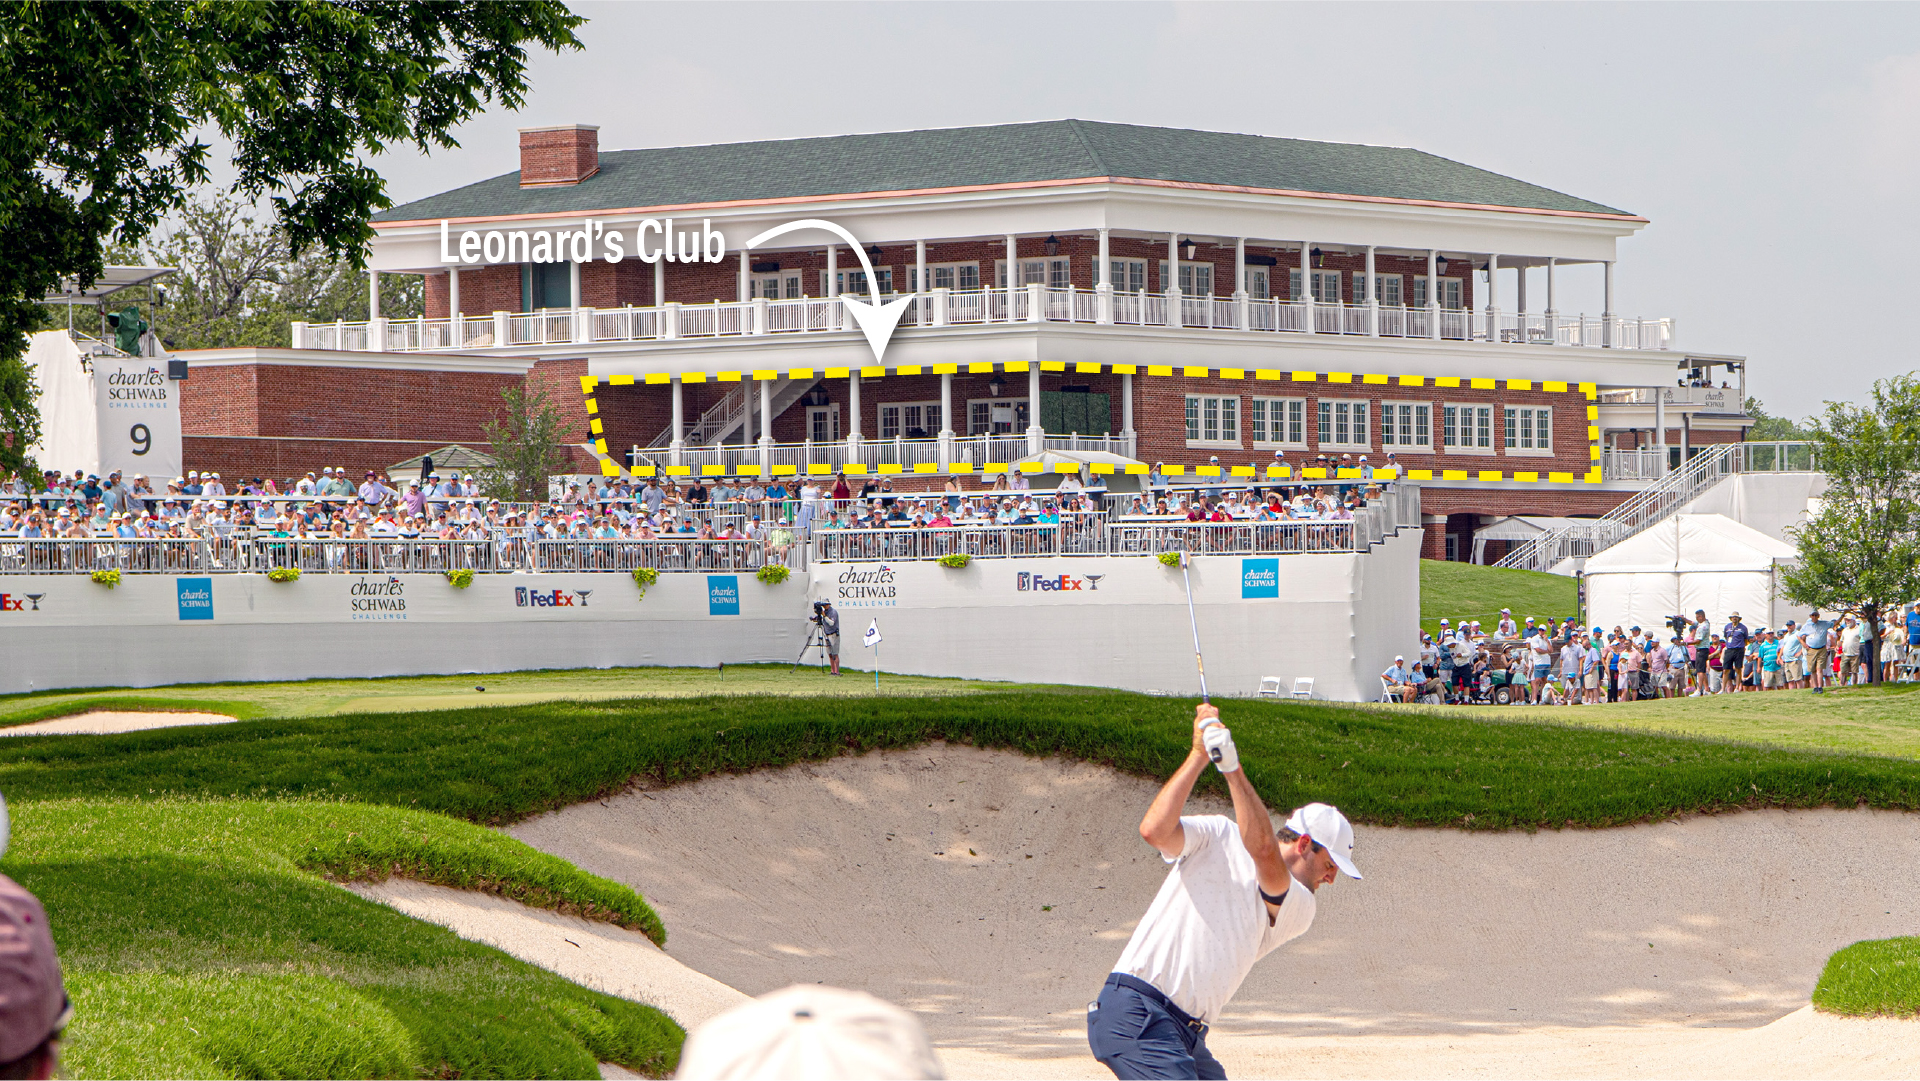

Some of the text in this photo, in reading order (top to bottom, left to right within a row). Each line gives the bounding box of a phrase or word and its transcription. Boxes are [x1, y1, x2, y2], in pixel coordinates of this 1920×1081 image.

[108, 366, 165, 386] charles
[109, 388, 167, 400] SCHWAB
[130, 423, 152, 457] 9
[838, 565, 896, 584] charles
[1244, 569, 1275, 580] charles
[350, 576, 404, 596] charles
[1033, 574, 1082, 591] FedEx
[1244, 580, 1276, 588] SCHWAB
[180, 589, 209, 600] charles
[711, 586, 736, 596] charles
[838, 586, 896, 599] SCHWAB
[180, 600, 210, 608] SCHWAB
[351, 598, 406, 611] SCHWAB
[530, 589, 574, 607] FedEx
[865, 627, 876, 637] 9
